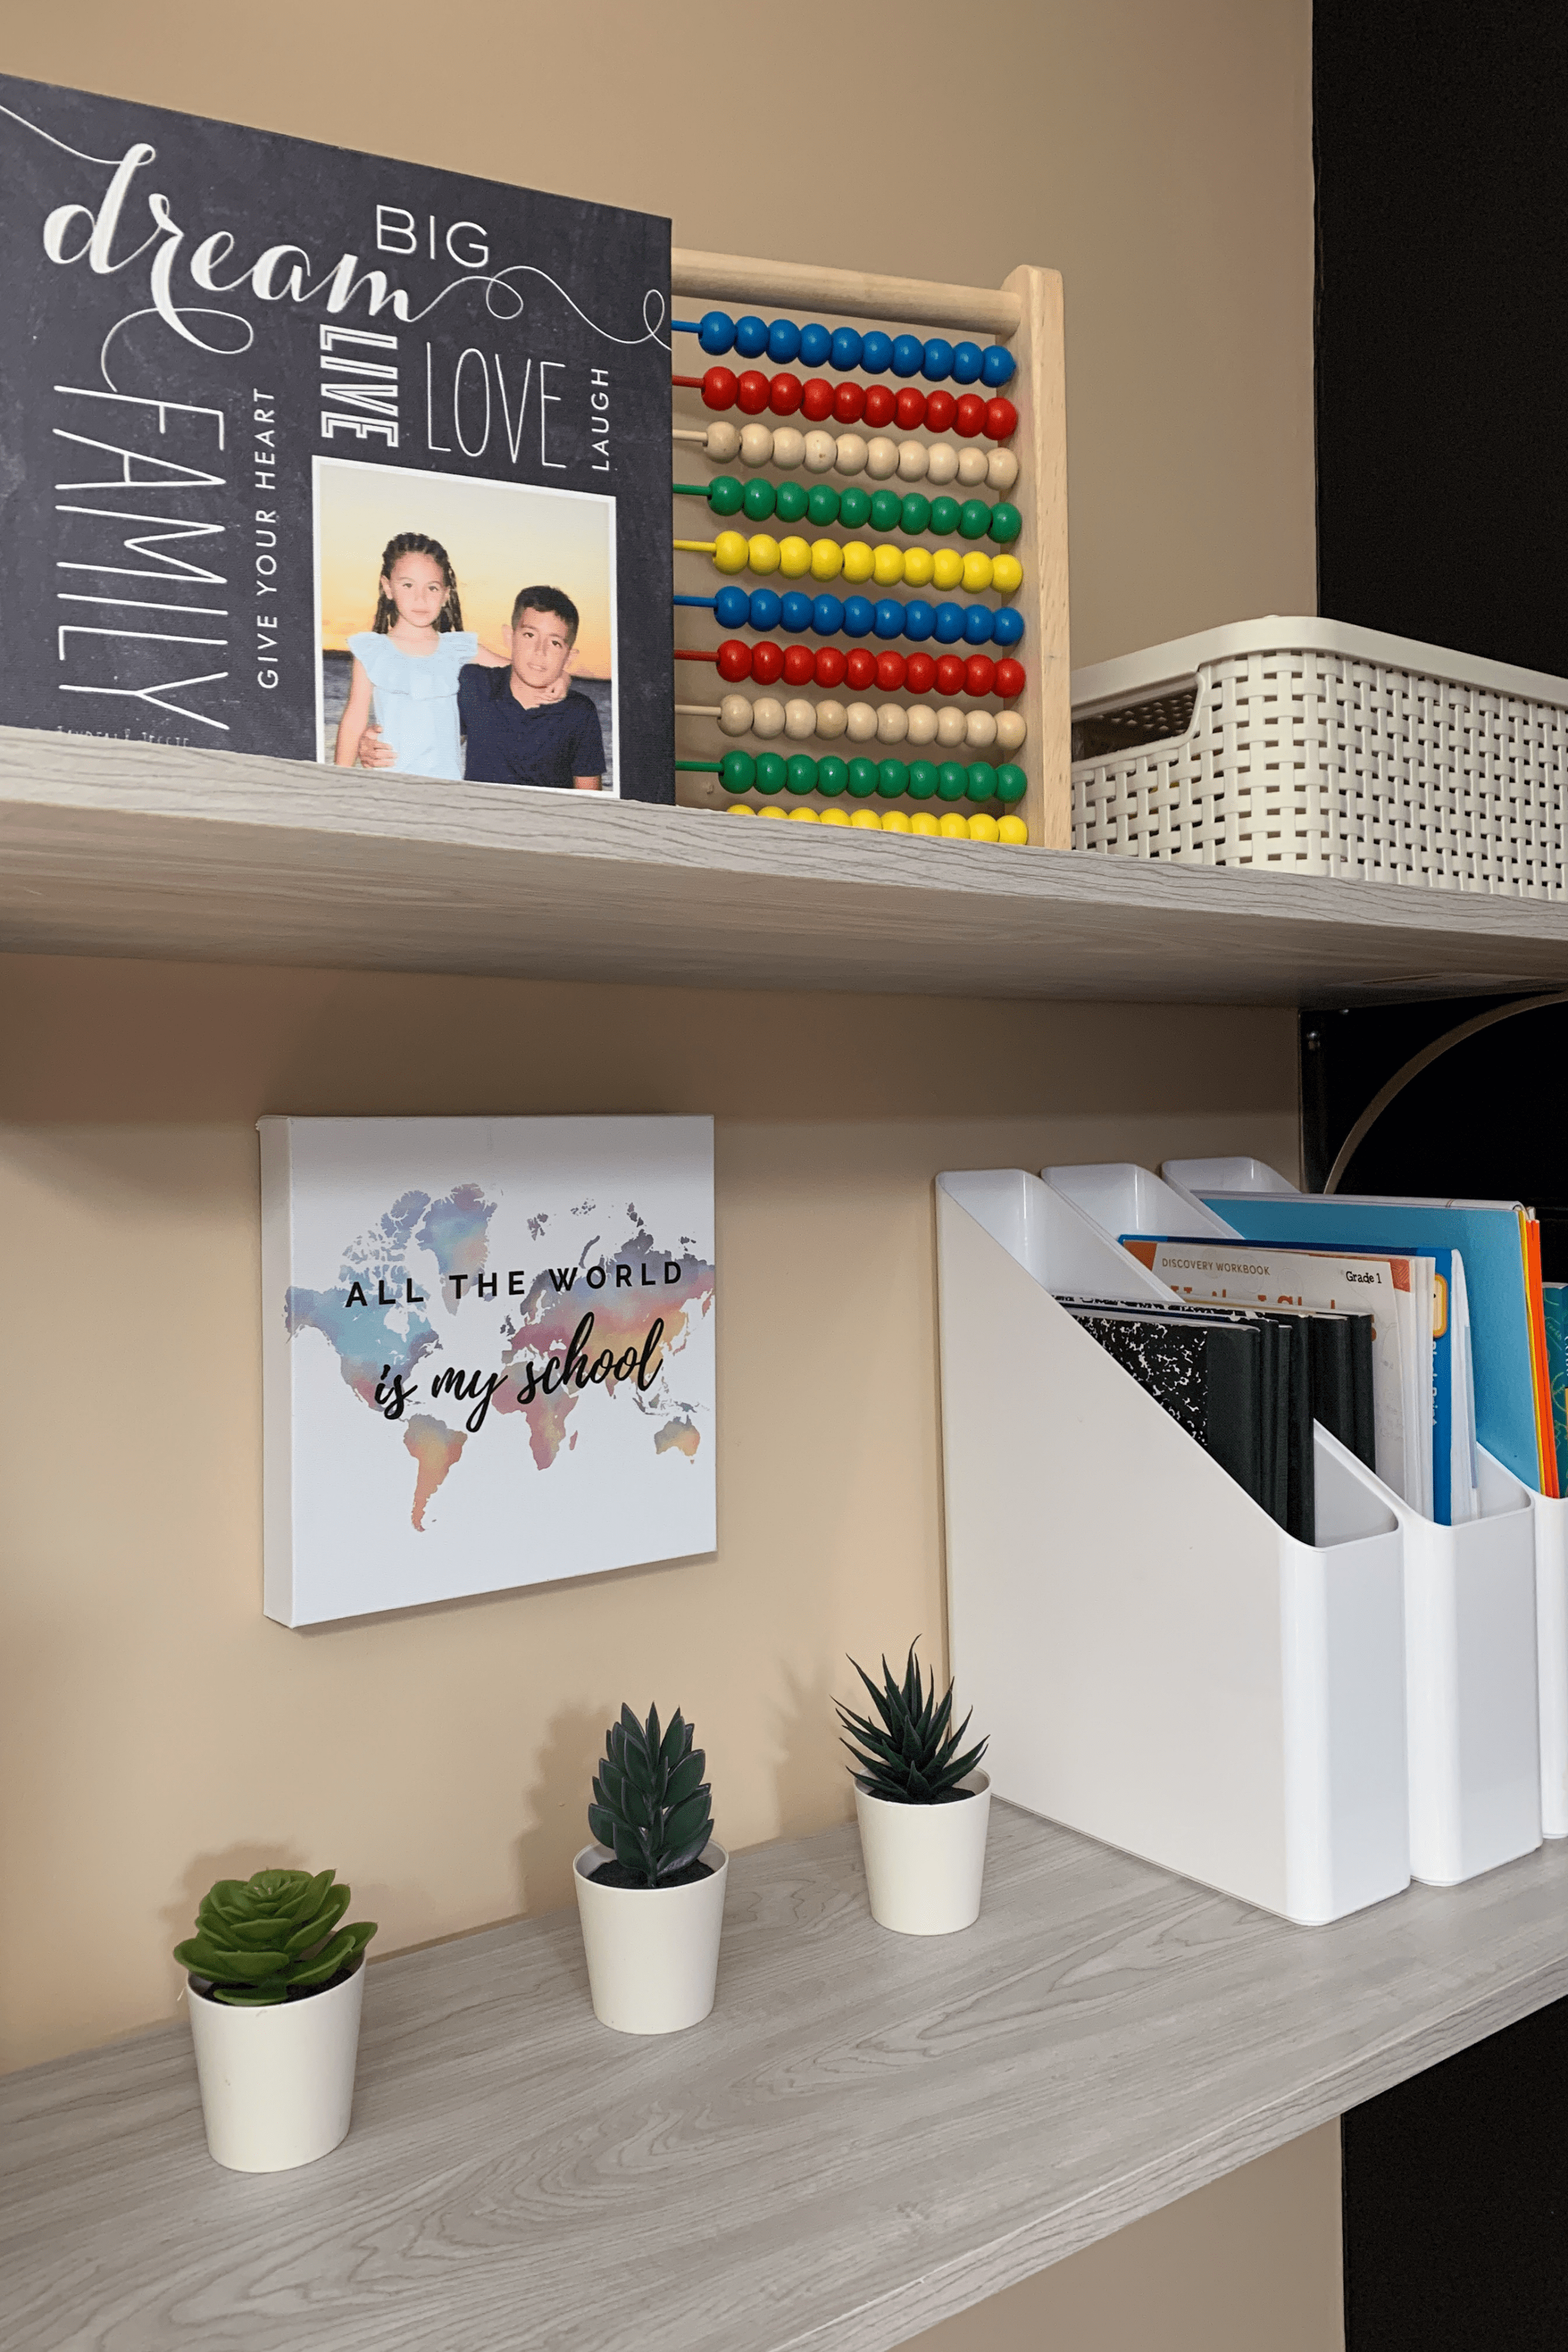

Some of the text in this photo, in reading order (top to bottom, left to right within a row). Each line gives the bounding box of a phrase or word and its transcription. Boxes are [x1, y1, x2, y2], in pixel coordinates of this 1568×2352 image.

[43, 143, 415, 354] dream
[376, 204, 489, 268] BIG
[320, 324, 399, 448] LIVE
[427, 342, 566, 469] LOVE
[591, 368, 610, 471] LAUGH
[53, 384, 230, 730] FAMILY
[253, 388, 278, 689] GIVE YOUR HEART
[346, 1261, 682, 1308] ALL THE WORLD
[1162, 1258, 1271, 1276] DISCOVERY WORKBOOK
[1345, 1271, 1382, 1284] Grade 1
[374, 1311, 665, 1433] is my school
